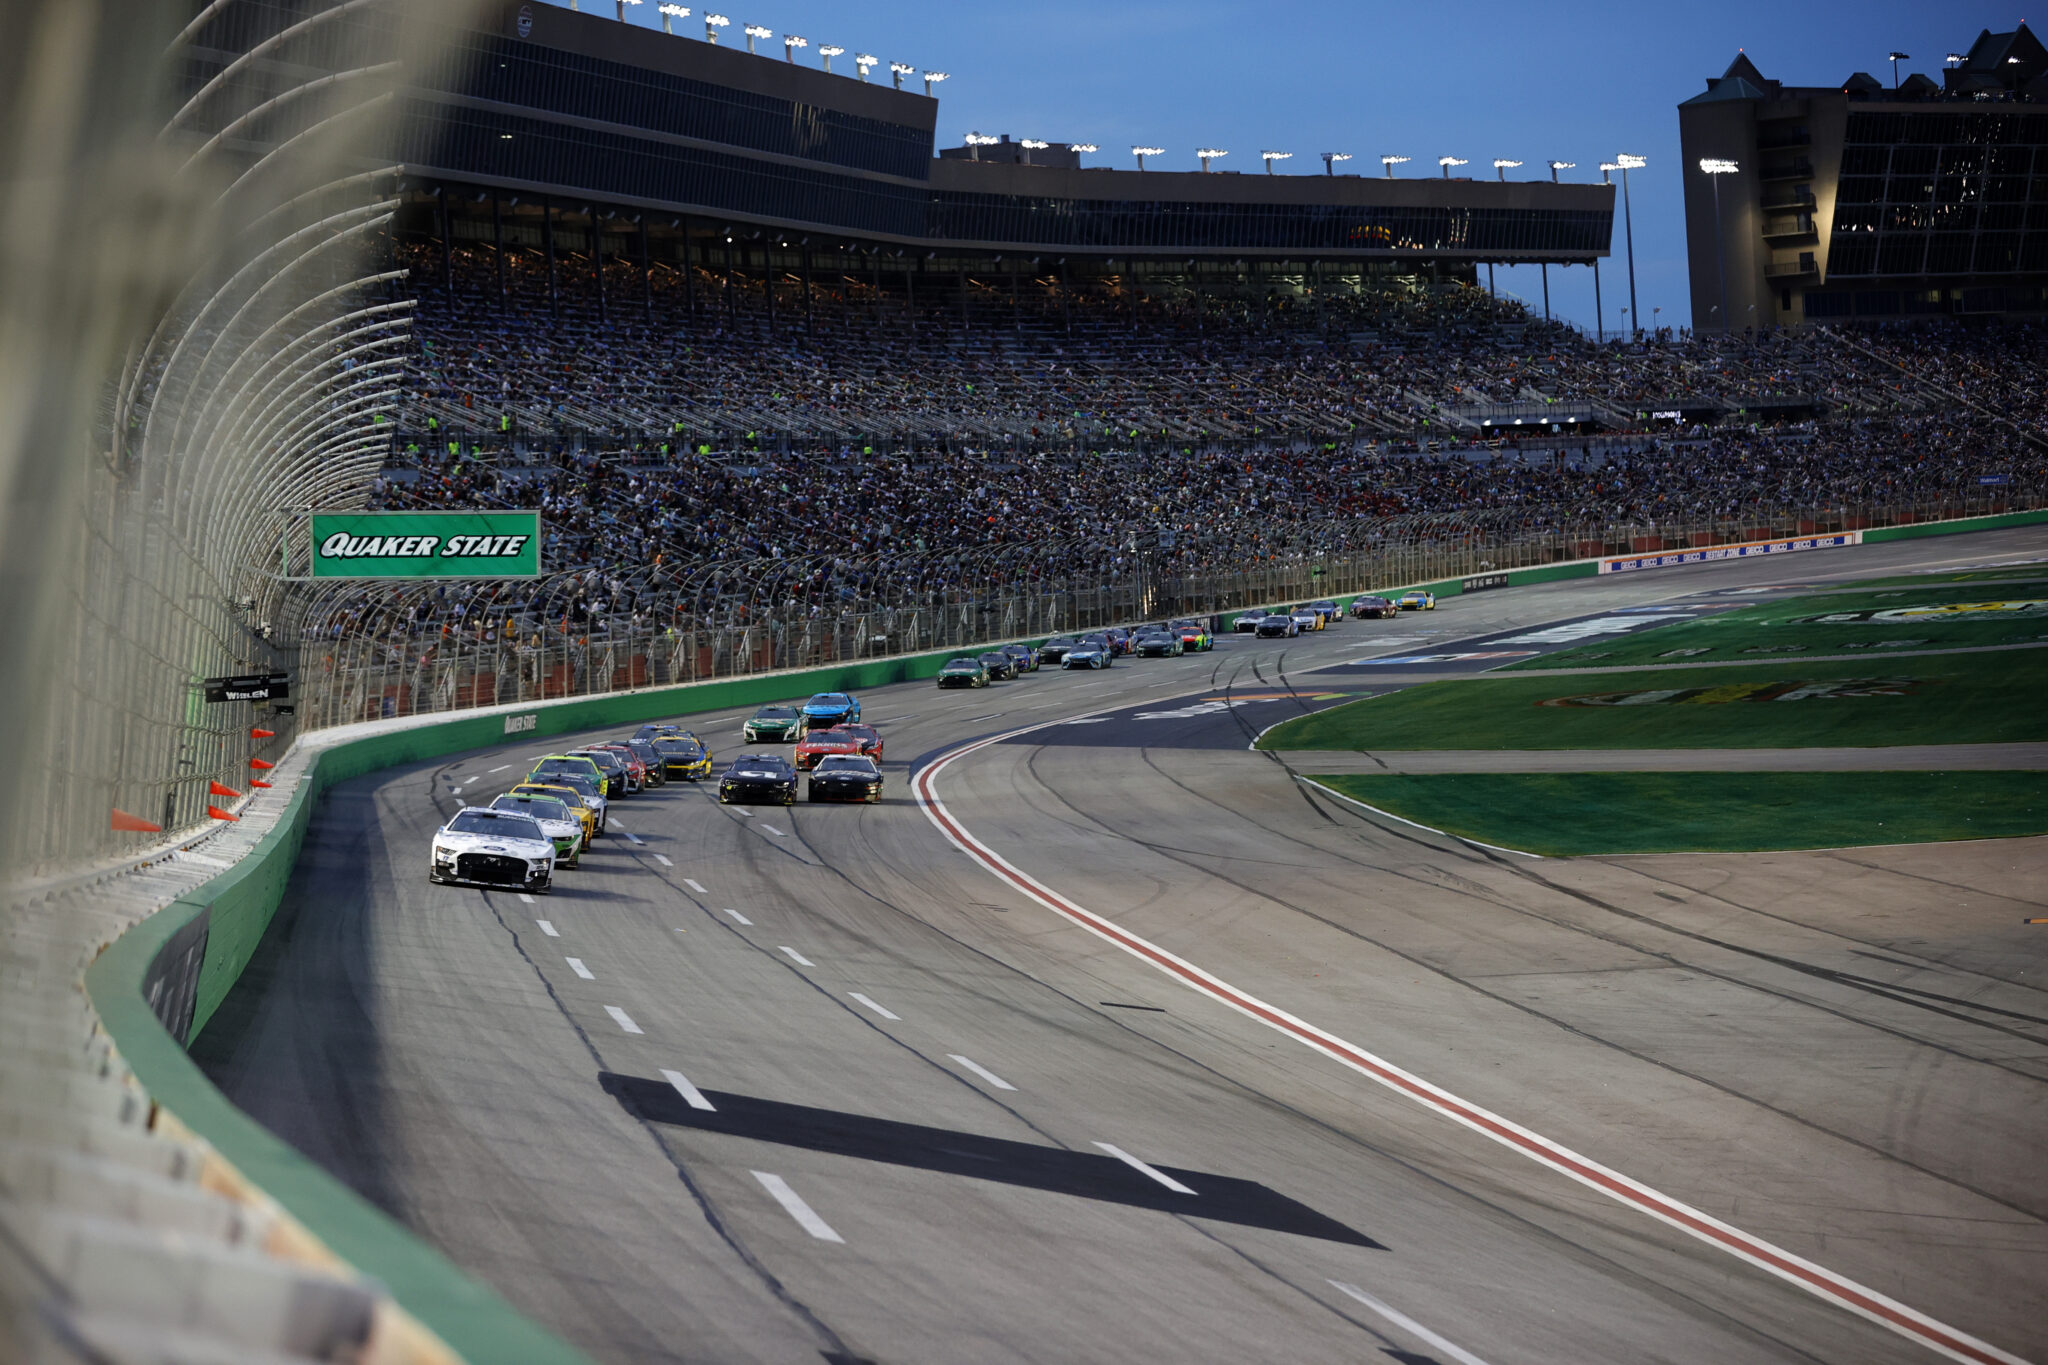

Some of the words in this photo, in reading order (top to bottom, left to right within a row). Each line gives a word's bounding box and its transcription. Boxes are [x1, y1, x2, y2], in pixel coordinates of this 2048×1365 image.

[321, 532, 440, 558] QUAKER
[441, 535, 528, 557] STATE
[1621, 560, 1637, 569] GEICO
[1661, 555, 1678, 566] GEICO
[1683, 553, 1700, 562] GEICO
[1746, 545, 1764, 555] GEICO
[1770, 543, 1787, 552] GEICO
[1793, 540, 1811, 550] GEICO
[1817, 538, 1834, 547] GEICO
[226, 689, 268, 700] WHELEN
[504, 715, 523, 734] QUAKER
